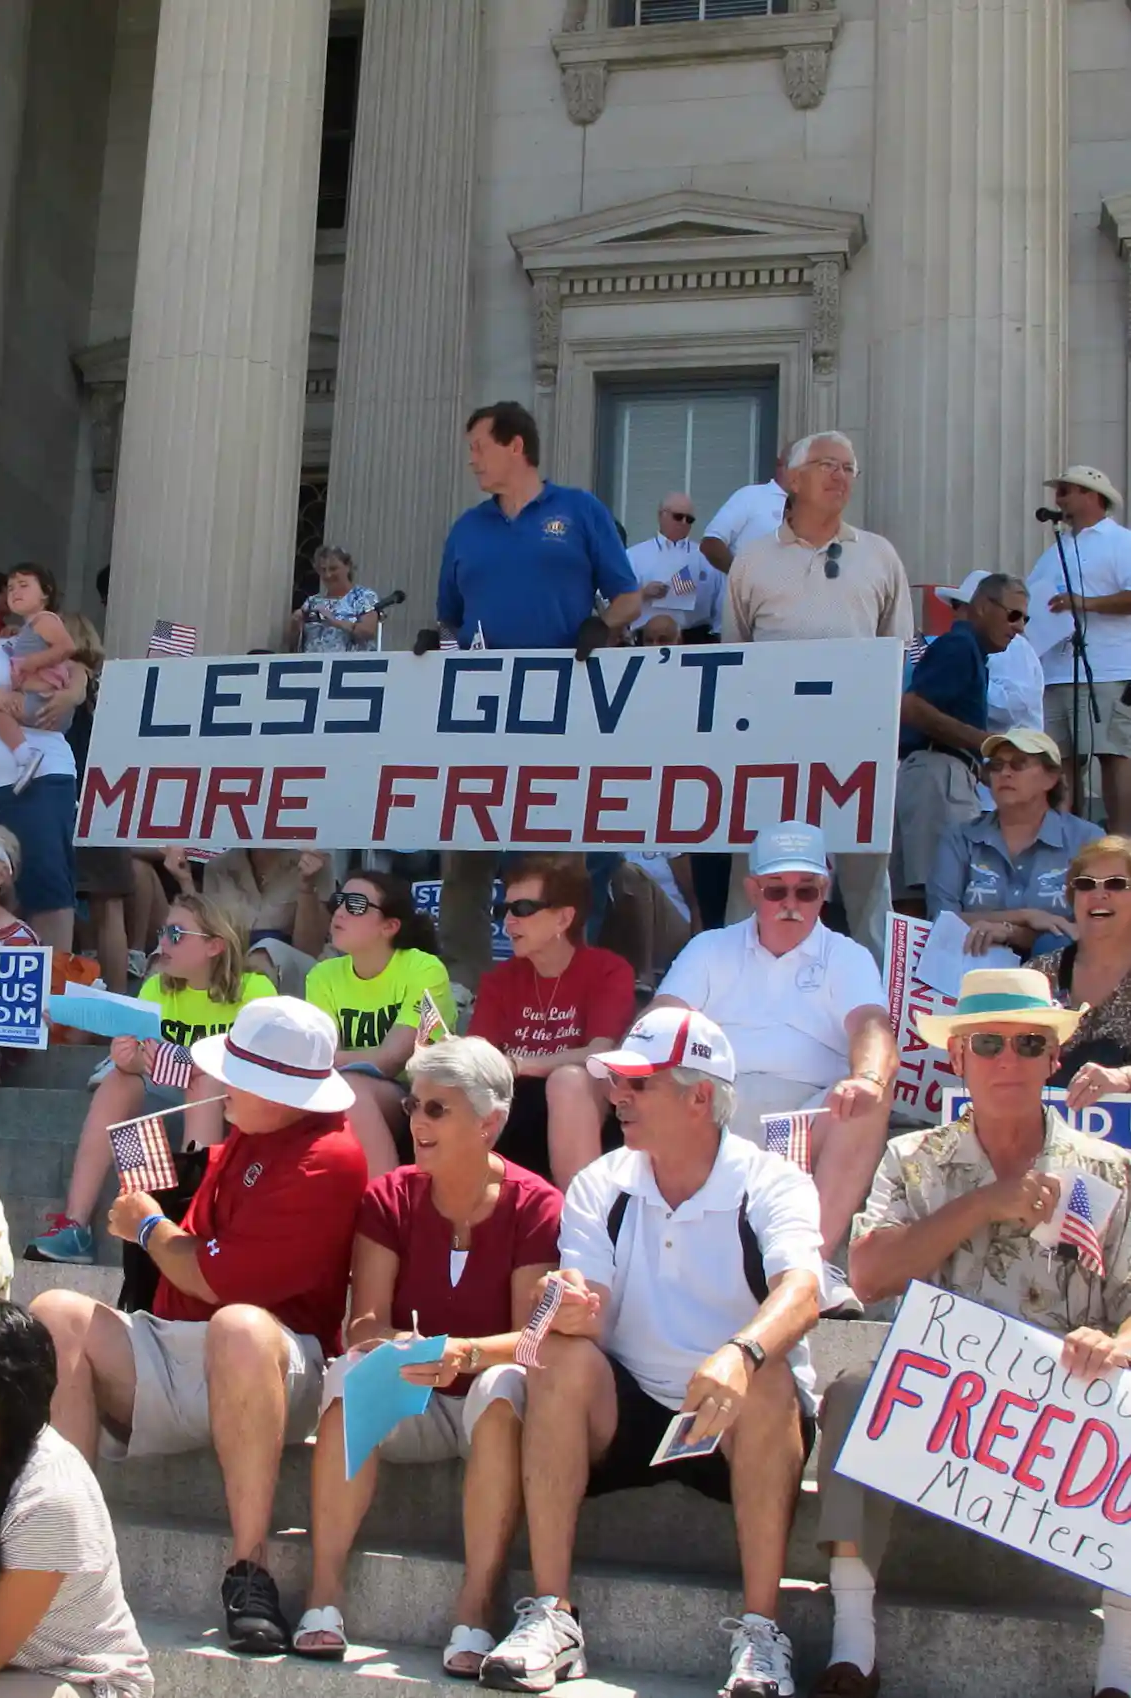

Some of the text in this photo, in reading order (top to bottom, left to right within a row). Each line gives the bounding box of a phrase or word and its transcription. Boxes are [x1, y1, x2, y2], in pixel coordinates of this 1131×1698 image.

[138, 658, 389, 737] LESS
[436, 647, 750, 736] GOV'T.
[77, 761, 877, 844] MORE FREEDOM
[515, 1027, 527, 1044] of
[532, 1027, 552, 1041] the
[522, 1006, 546, 1021] Our
[917, 1460, 1115, 1571] Matters
